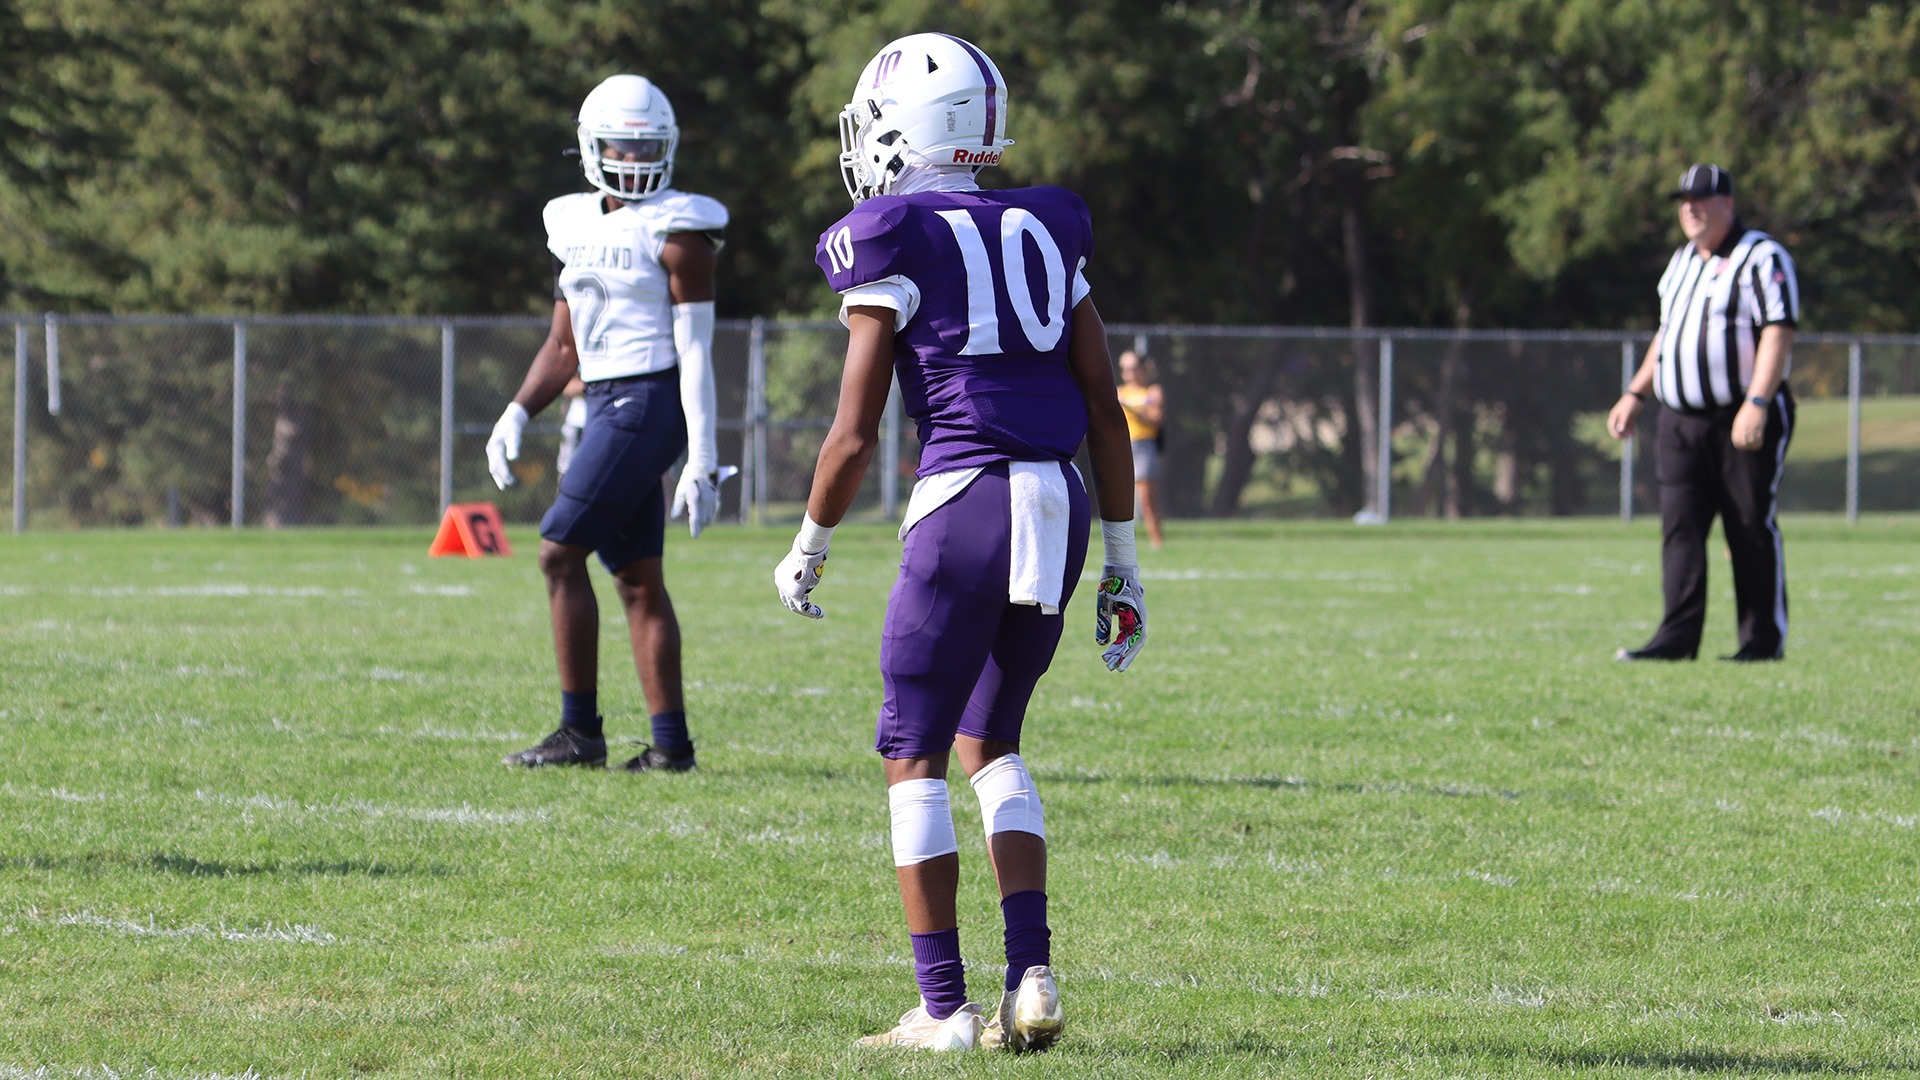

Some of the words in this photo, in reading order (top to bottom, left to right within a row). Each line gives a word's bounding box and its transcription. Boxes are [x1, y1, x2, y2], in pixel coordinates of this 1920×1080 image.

[873, 50, 902, 89] 10
[587, 245, 632, 270] LAND
[825, 225, 854, 275] 10
[934, 207, 1066, 356] 10
[569, 272, 609, 357] 2
[470, 513, 500, 555] G
